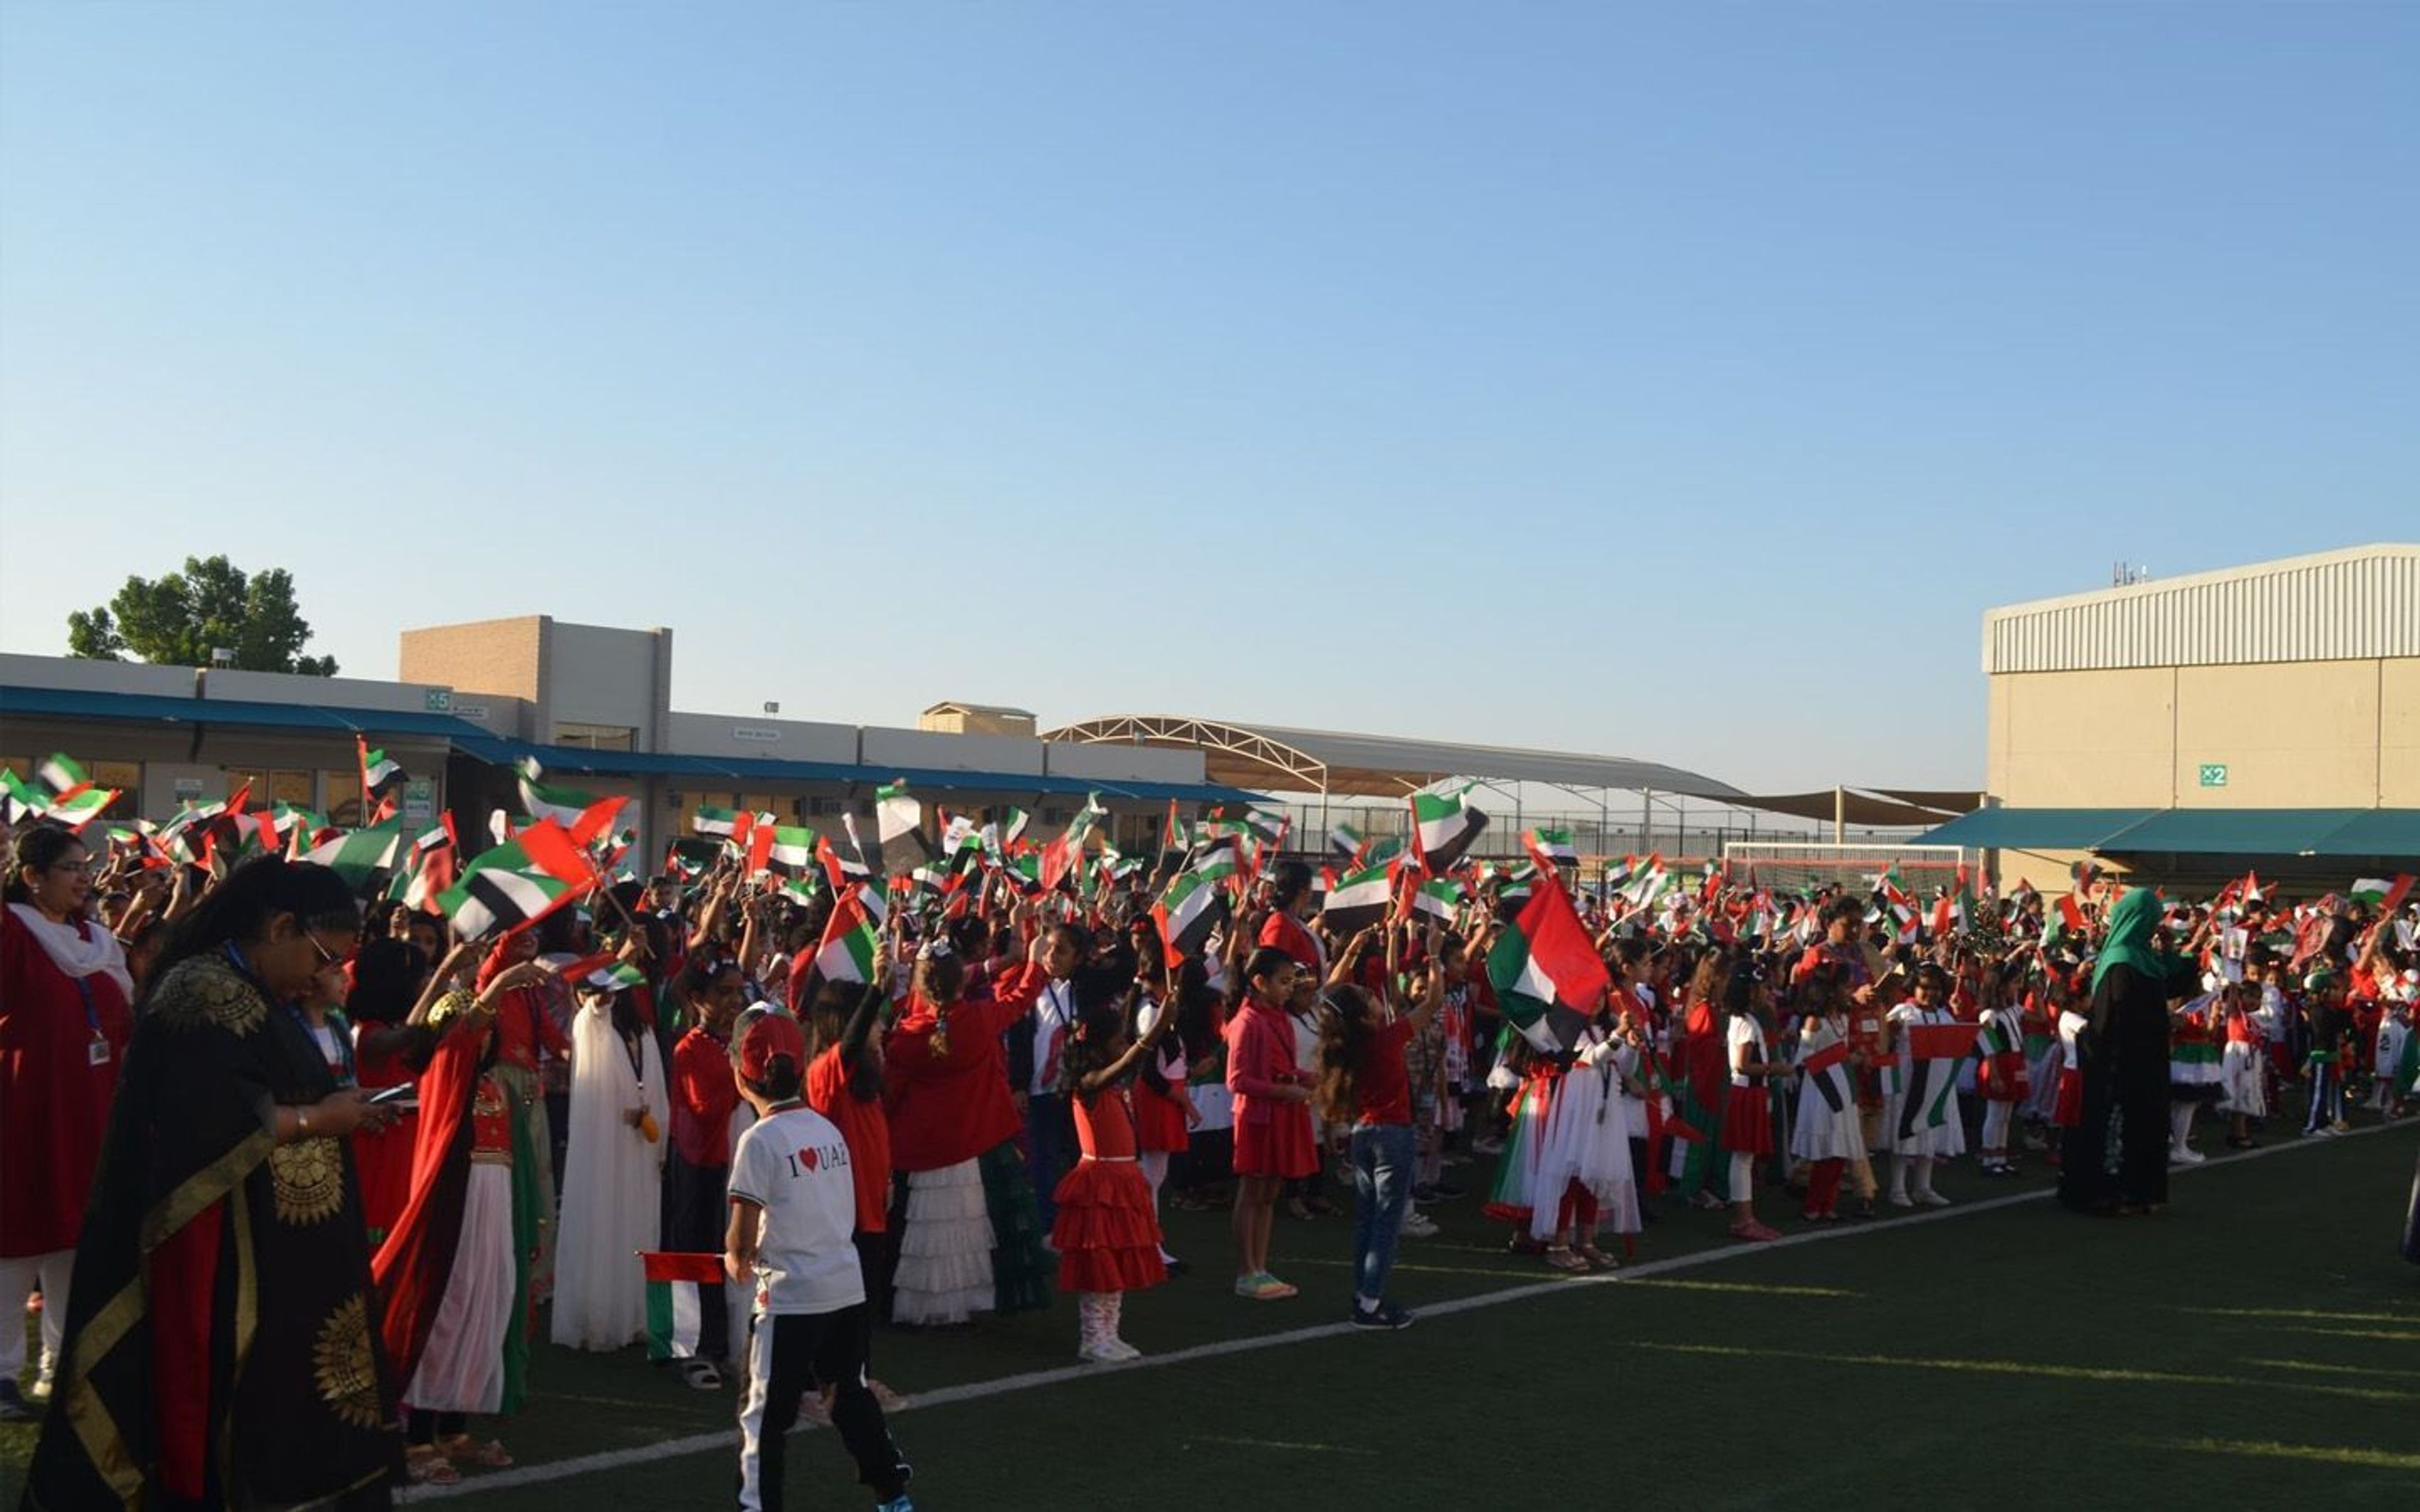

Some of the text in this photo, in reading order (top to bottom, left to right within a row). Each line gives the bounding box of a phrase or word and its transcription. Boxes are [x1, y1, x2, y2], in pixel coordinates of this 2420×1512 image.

[2214, 767, 2225, 784] 2
[785, 1142, 848, 1179] I UAE
